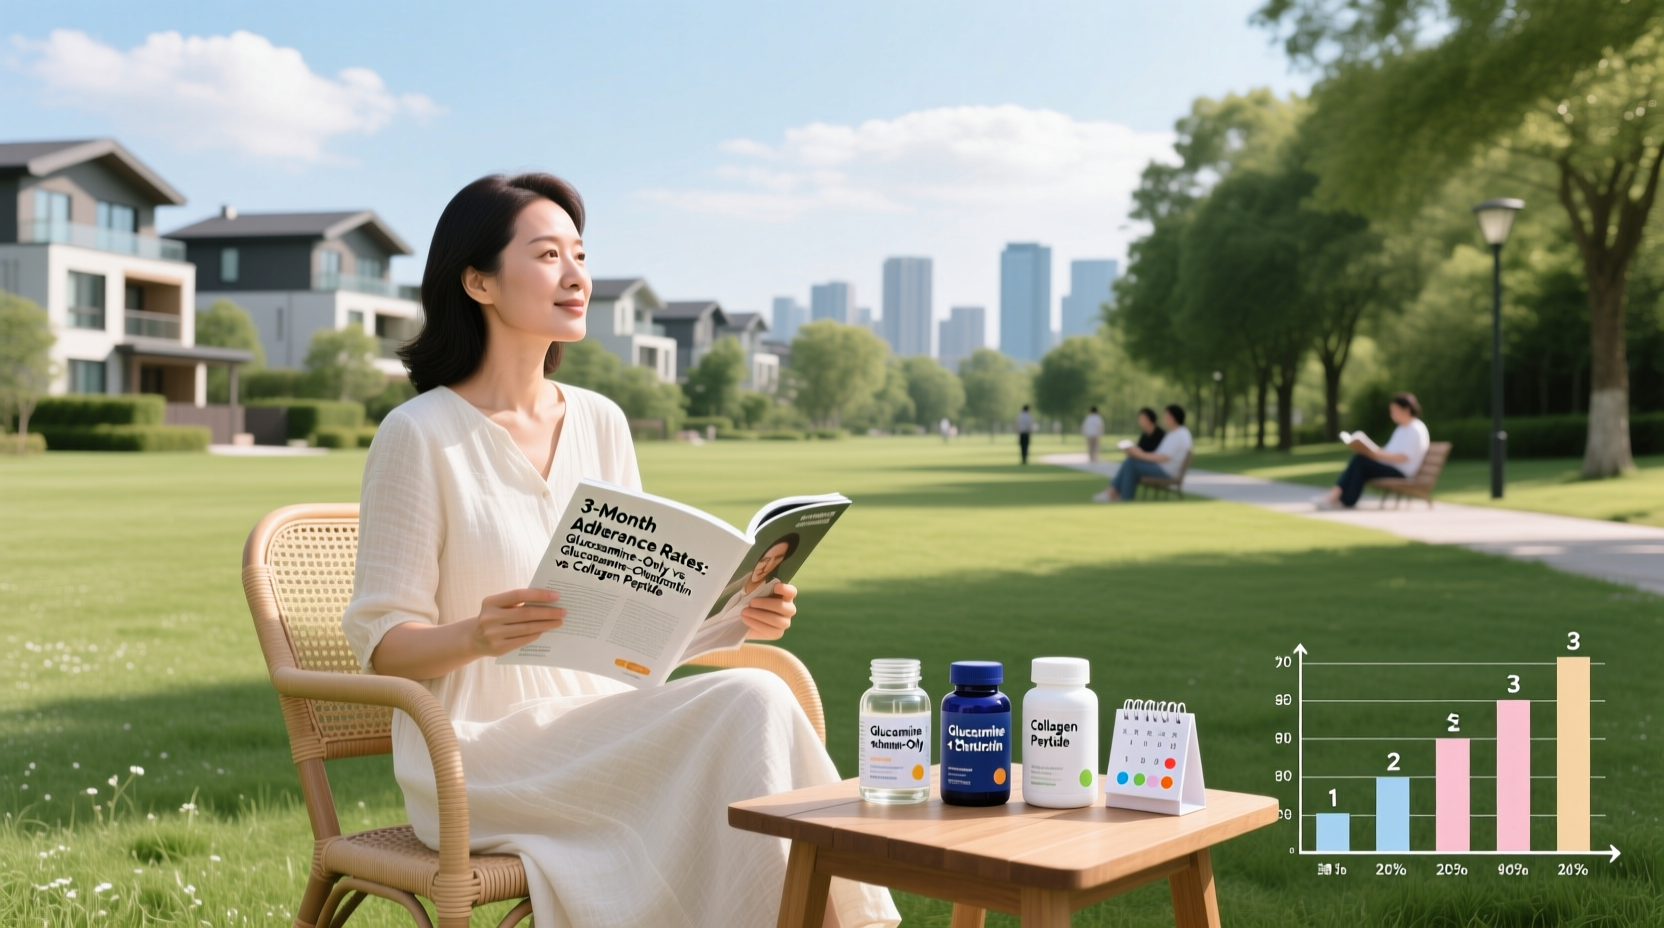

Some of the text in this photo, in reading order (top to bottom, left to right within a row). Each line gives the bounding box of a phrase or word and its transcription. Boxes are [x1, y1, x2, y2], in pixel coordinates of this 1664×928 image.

[581, 498, 657, 533] 3-Month
[660, 543, 709, 576] Rates:
[1031, 719, 1078, 736] Collagen
